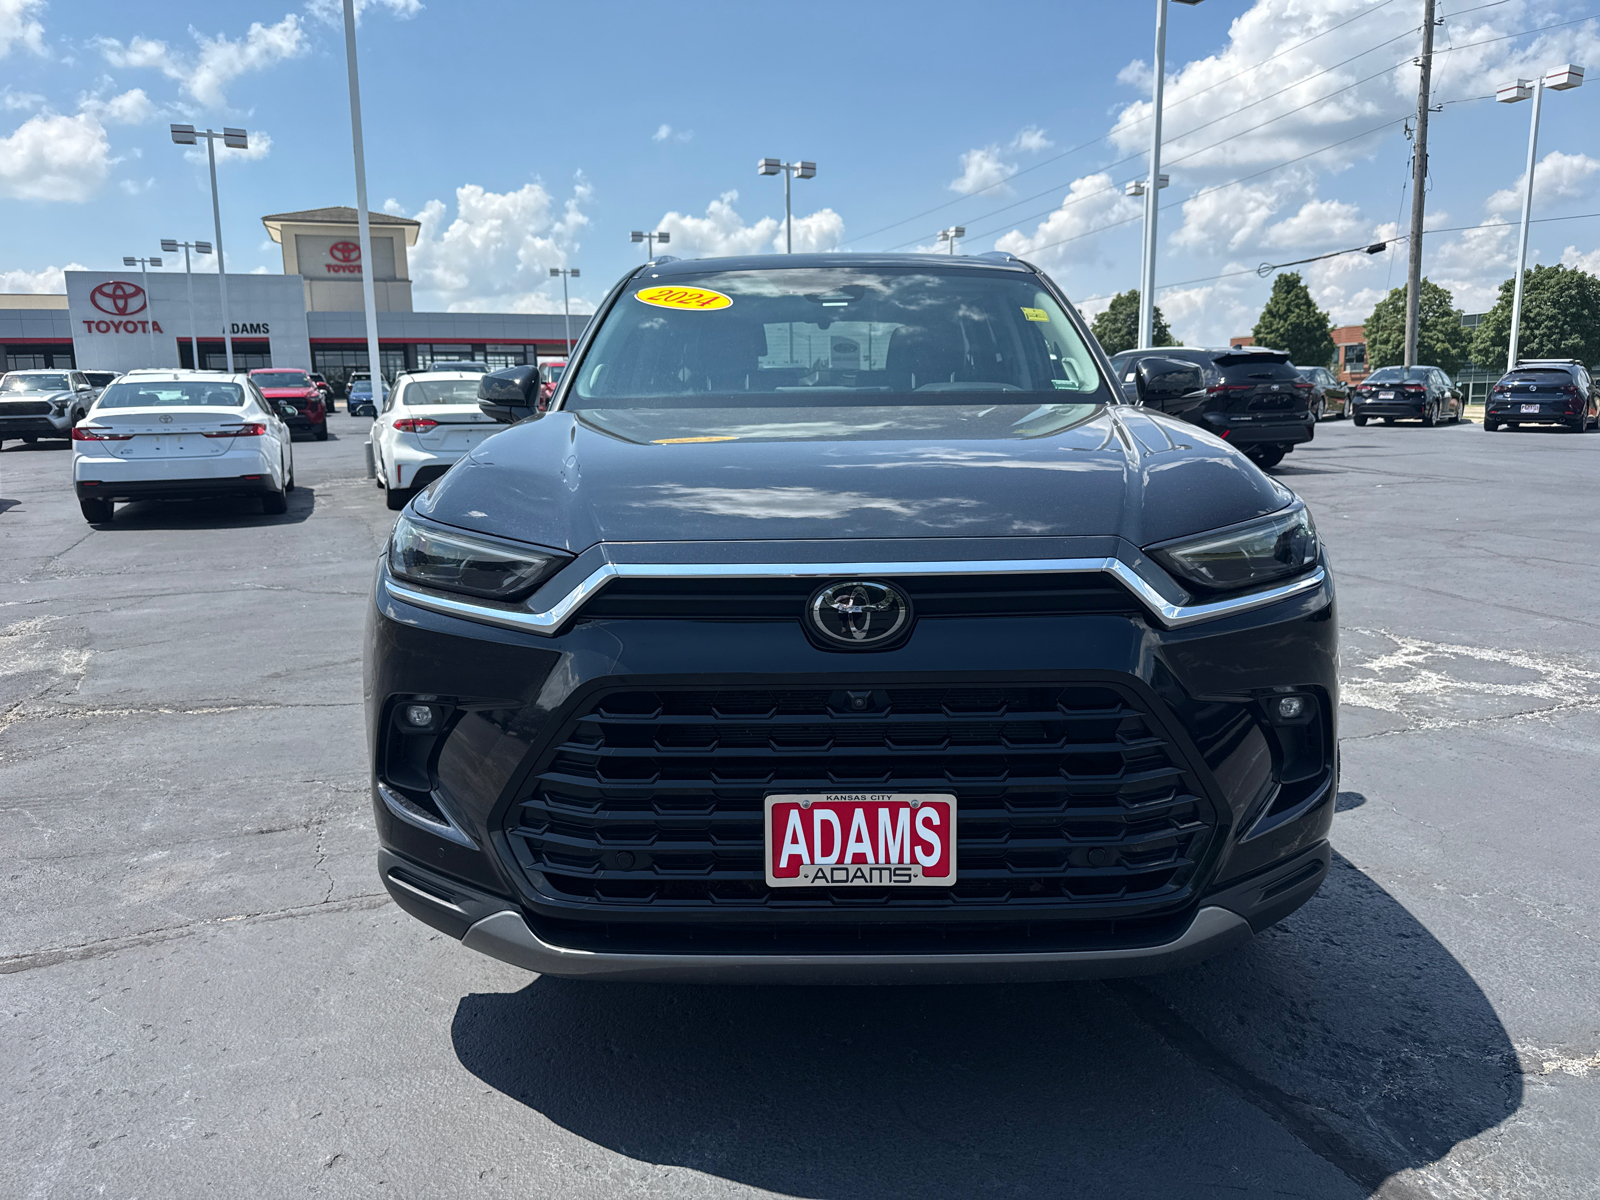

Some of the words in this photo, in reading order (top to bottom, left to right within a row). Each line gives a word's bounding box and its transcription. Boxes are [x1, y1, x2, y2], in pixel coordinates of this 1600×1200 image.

[325, 264, 363, 273] TOYOT
[647, 290, 720, 307] 2024
[82, 320, 164, 334] TOYOTA
[779, 806, 942, 868] ADAMS
[810, 867, 912, 884] ADAMS
